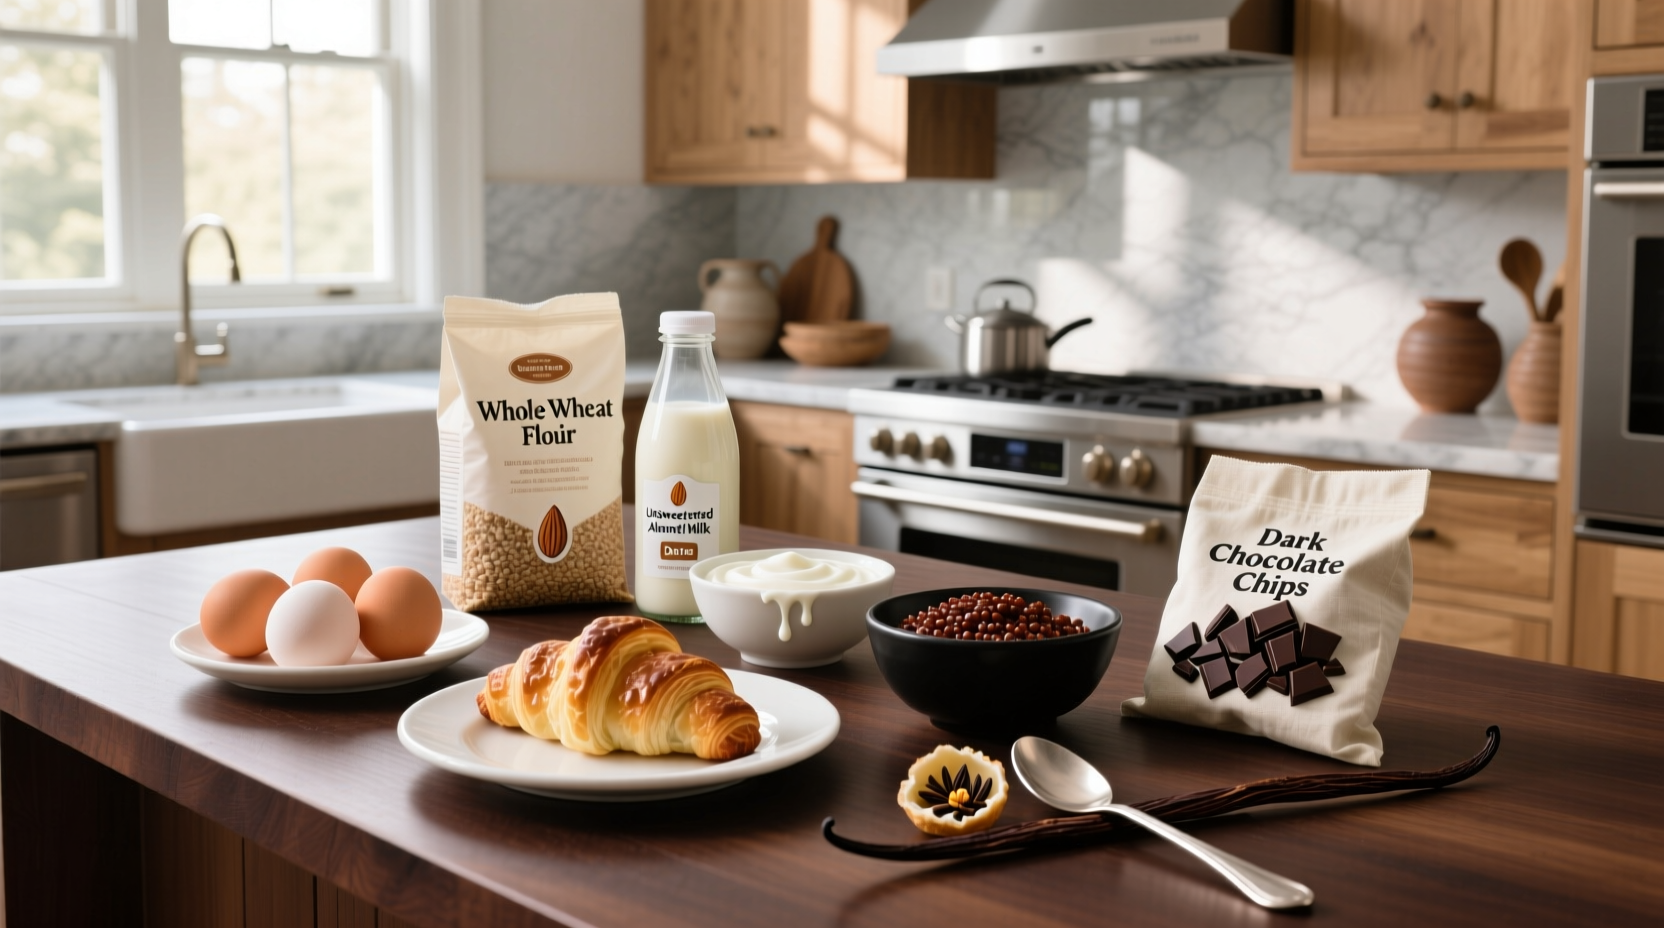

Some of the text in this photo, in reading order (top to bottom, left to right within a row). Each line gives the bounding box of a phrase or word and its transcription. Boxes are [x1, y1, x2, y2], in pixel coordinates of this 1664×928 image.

[477, 397, 613, 421] Whole Wheat
[522, 423, 576, 446] Flour
[1257, 528, 1327, 551] Dark
[1209, 543, 1344, 575] Chocolate
[1233, 572, 1309, 601] Chips
